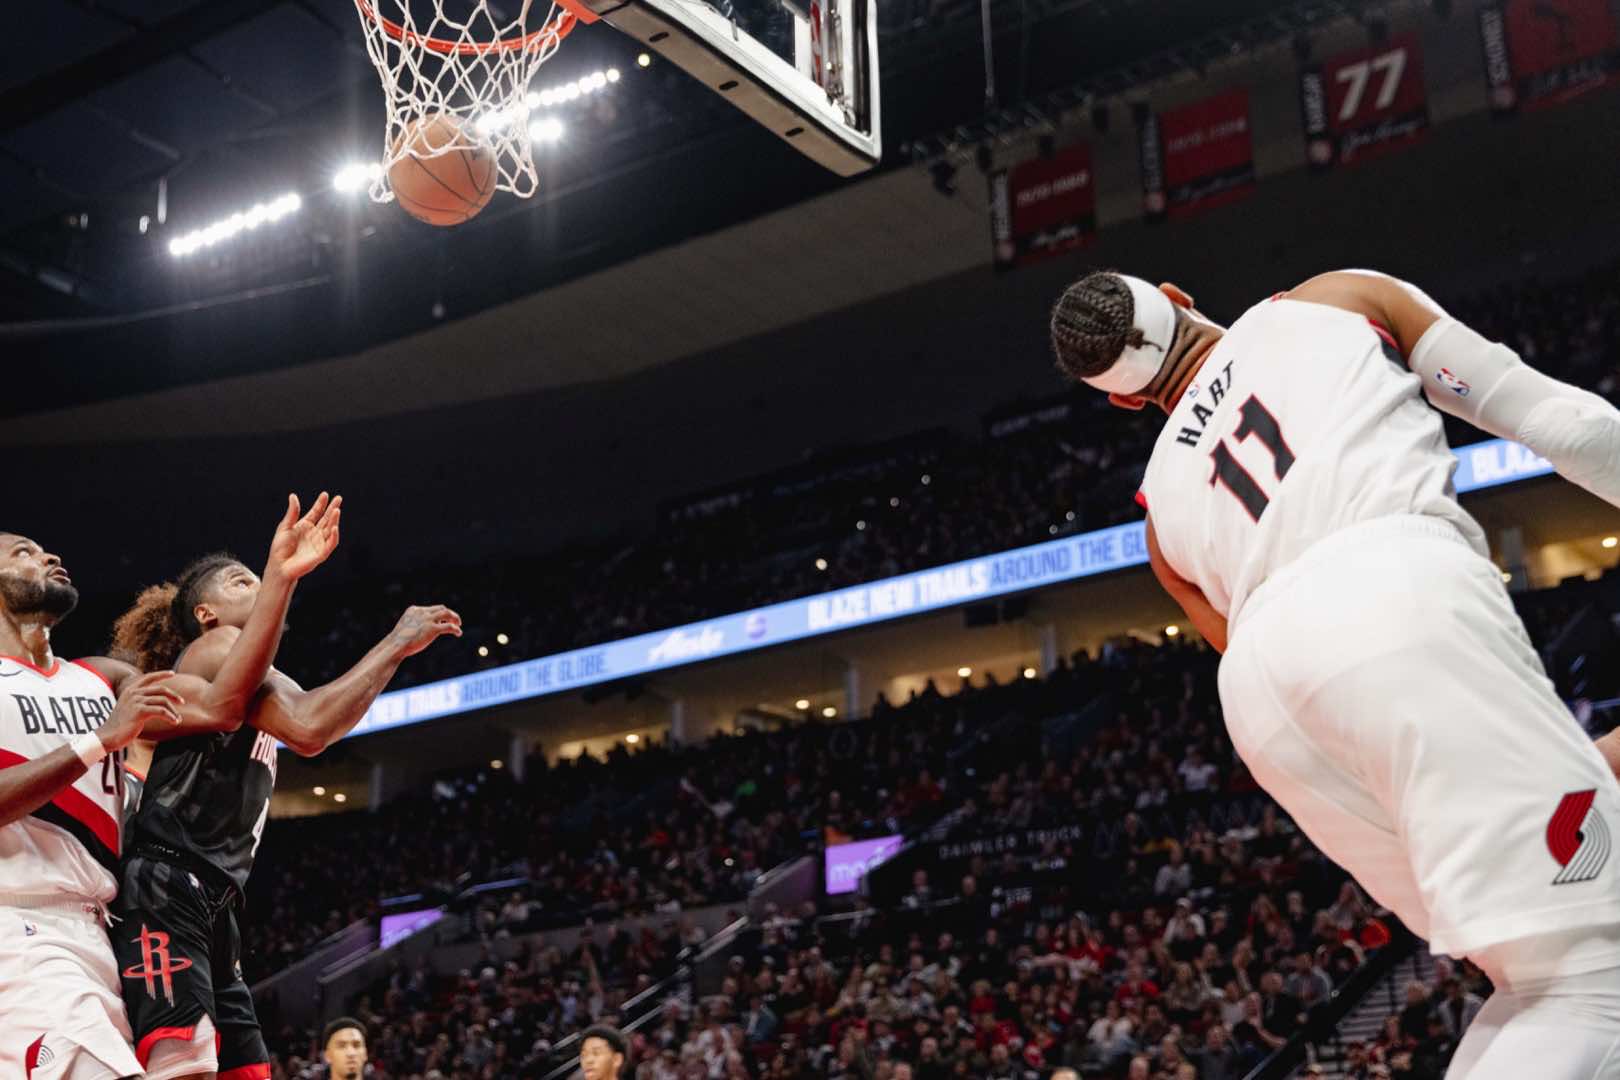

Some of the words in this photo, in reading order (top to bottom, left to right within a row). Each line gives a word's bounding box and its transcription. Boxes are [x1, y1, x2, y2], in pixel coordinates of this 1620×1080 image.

[1335, 46, 1408, 121] 77
[1176, 359, 1234, 448] HART
[1208, 391, 1297, 526] 11
[1472, 439, 1554, 482] BLAZ
[807, 587, 866, 630] BLAZE
[918, 562, 988, 604] TRAILS
[990, 546, 1071, 587] AROUND
[1075, 535, 1115, 568] THE
[463, 670, 521, 703] AROUND
[525, 661, 553, 690] THE
[559, 651, 608, 682] GLOBE
[938, 833, 1017, 859] DAIMLER
[1026, 824, 1082, 846] TRUCK
